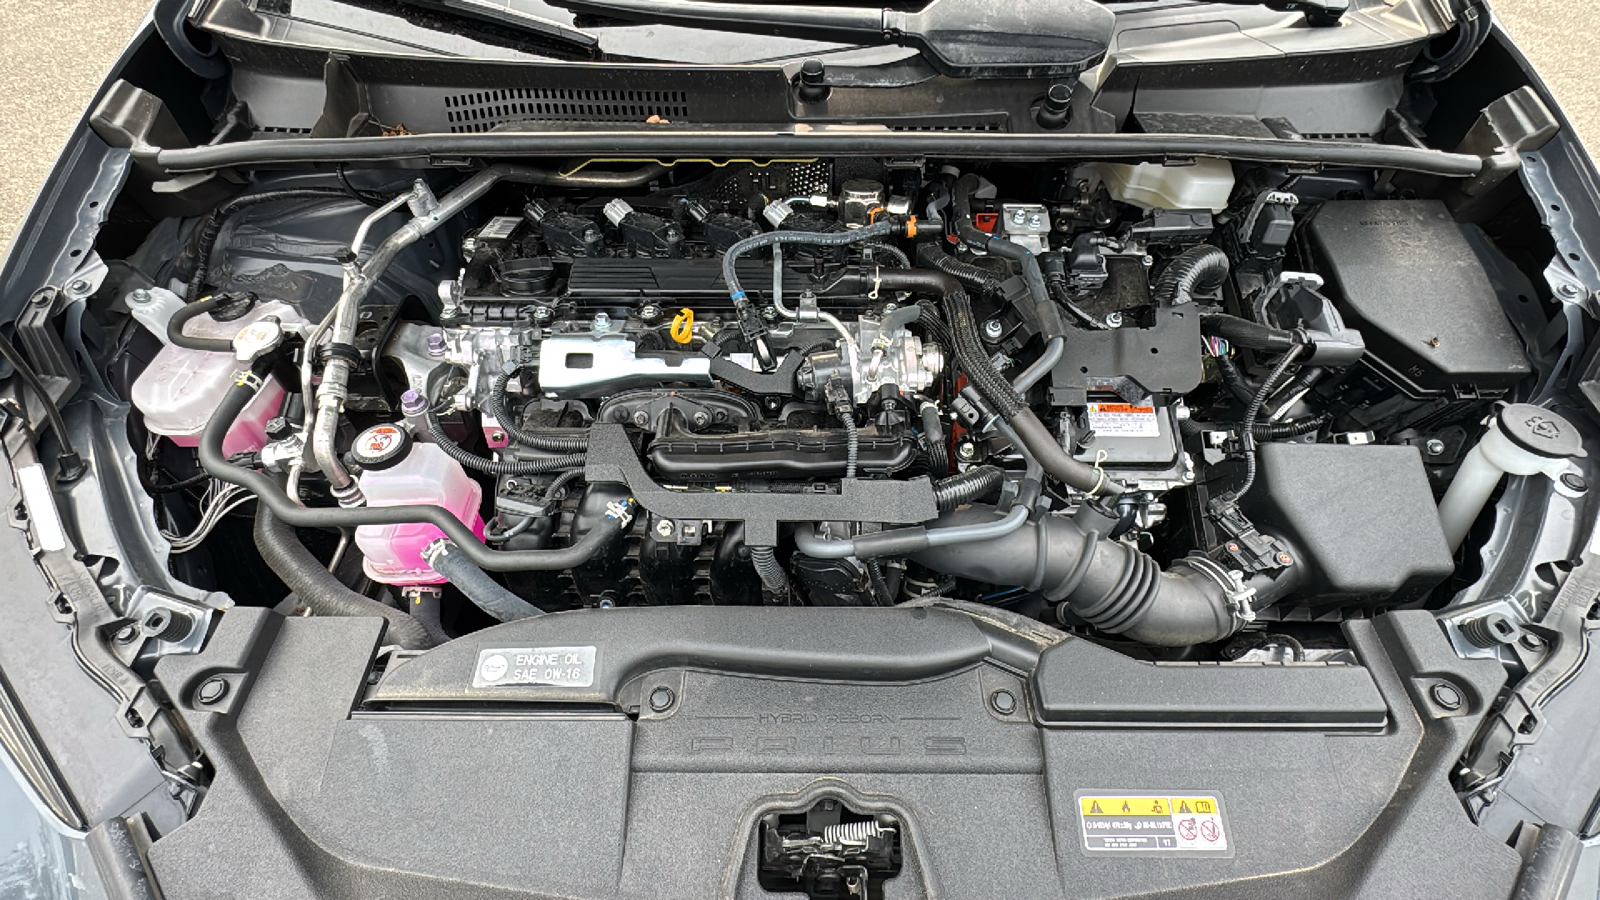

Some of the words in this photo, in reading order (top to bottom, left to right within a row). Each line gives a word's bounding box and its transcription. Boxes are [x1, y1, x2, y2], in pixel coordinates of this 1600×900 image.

[515, 654, 559, 666] ENGINE
[564, 653, 582, 665] OIL
[513, 668, 538, 680] SAE
[544, 668, 581, 680] 0W-16
[758, 713, 818, 724] HYBRID
[825, 713, 896, 724] REBORN
[691, 736, 967, 756] PRIUS
